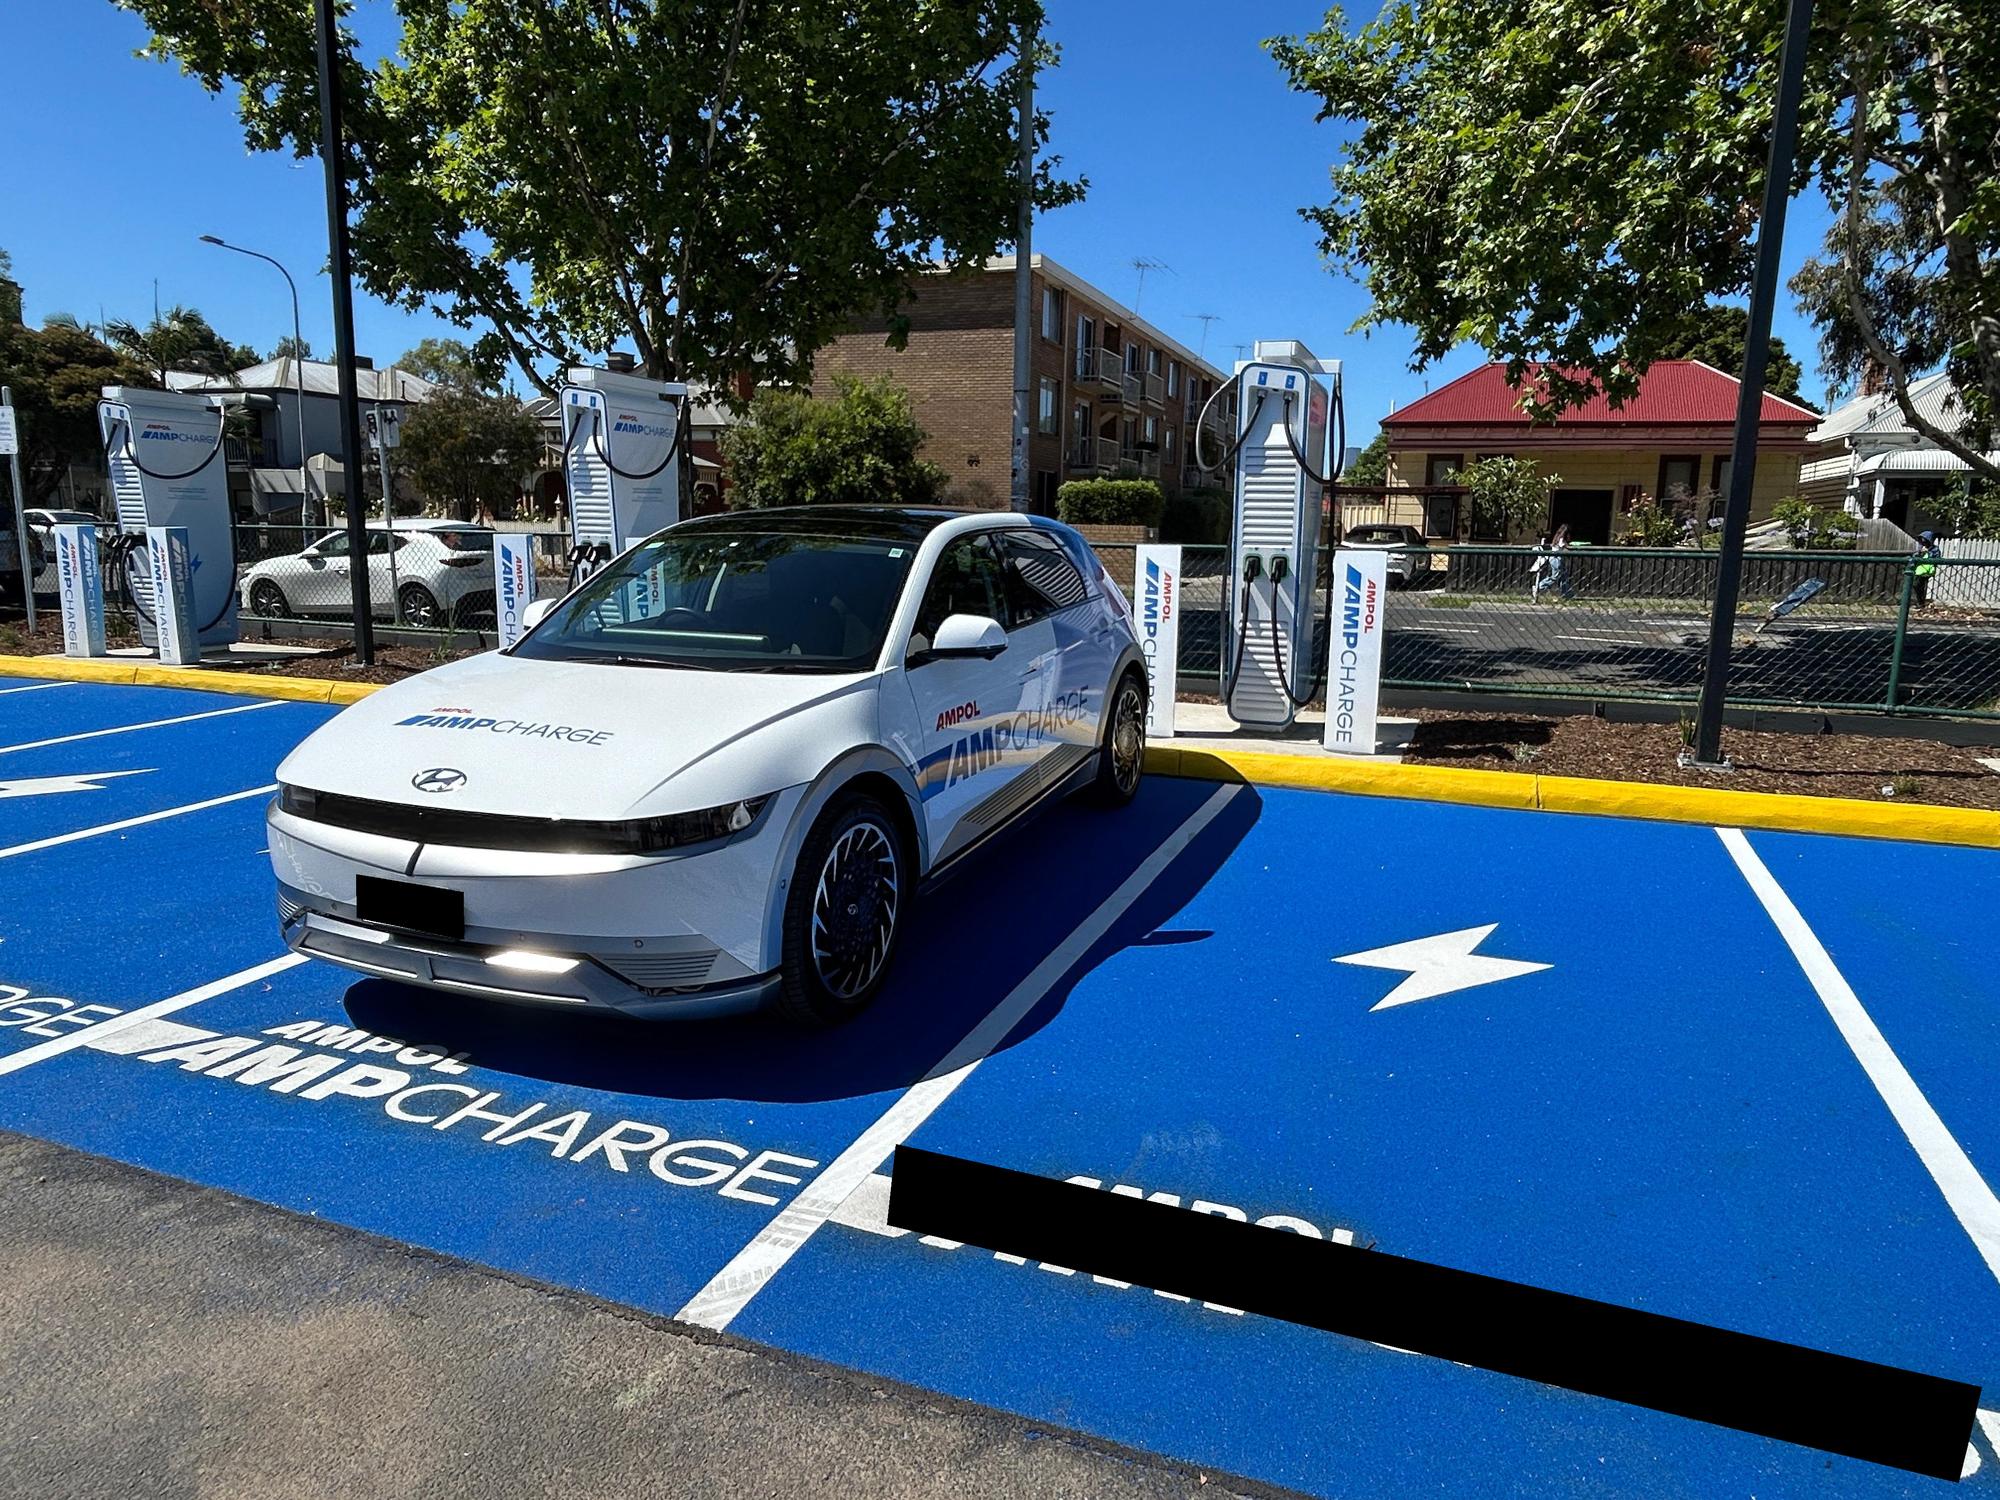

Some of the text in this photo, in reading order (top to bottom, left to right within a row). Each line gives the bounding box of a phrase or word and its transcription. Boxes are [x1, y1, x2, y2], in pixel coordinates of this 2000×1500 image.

[621, 423, 676, 438] AMPCHARGE
[69, 543, 78, 580] AMPOL
[159, 546, 168, 583] AMPOL
[515, 556, 524, 598] AMPOL
[60, 548, 78, 651] AMPCHARGE
[152, 551, 172, 657] AMPCHARGE
[501, 562, 517, 647] AMPCHA
[1162, 572, 1172, 623] AMPOL
[1364, 579, 1376, 634] AMPOL
[1336, 588, 1360, 743] AMPCHARGE
[421, 716, 615, 746] AMPCHARGE
[936, 700, 981, 732] AMPOL
[949, 685, 1090, 788] AMPCHARGE
[261, 1020, 471, 1074] AMPOL
[173, 1040, 820, 1205] AMPCHARGE
